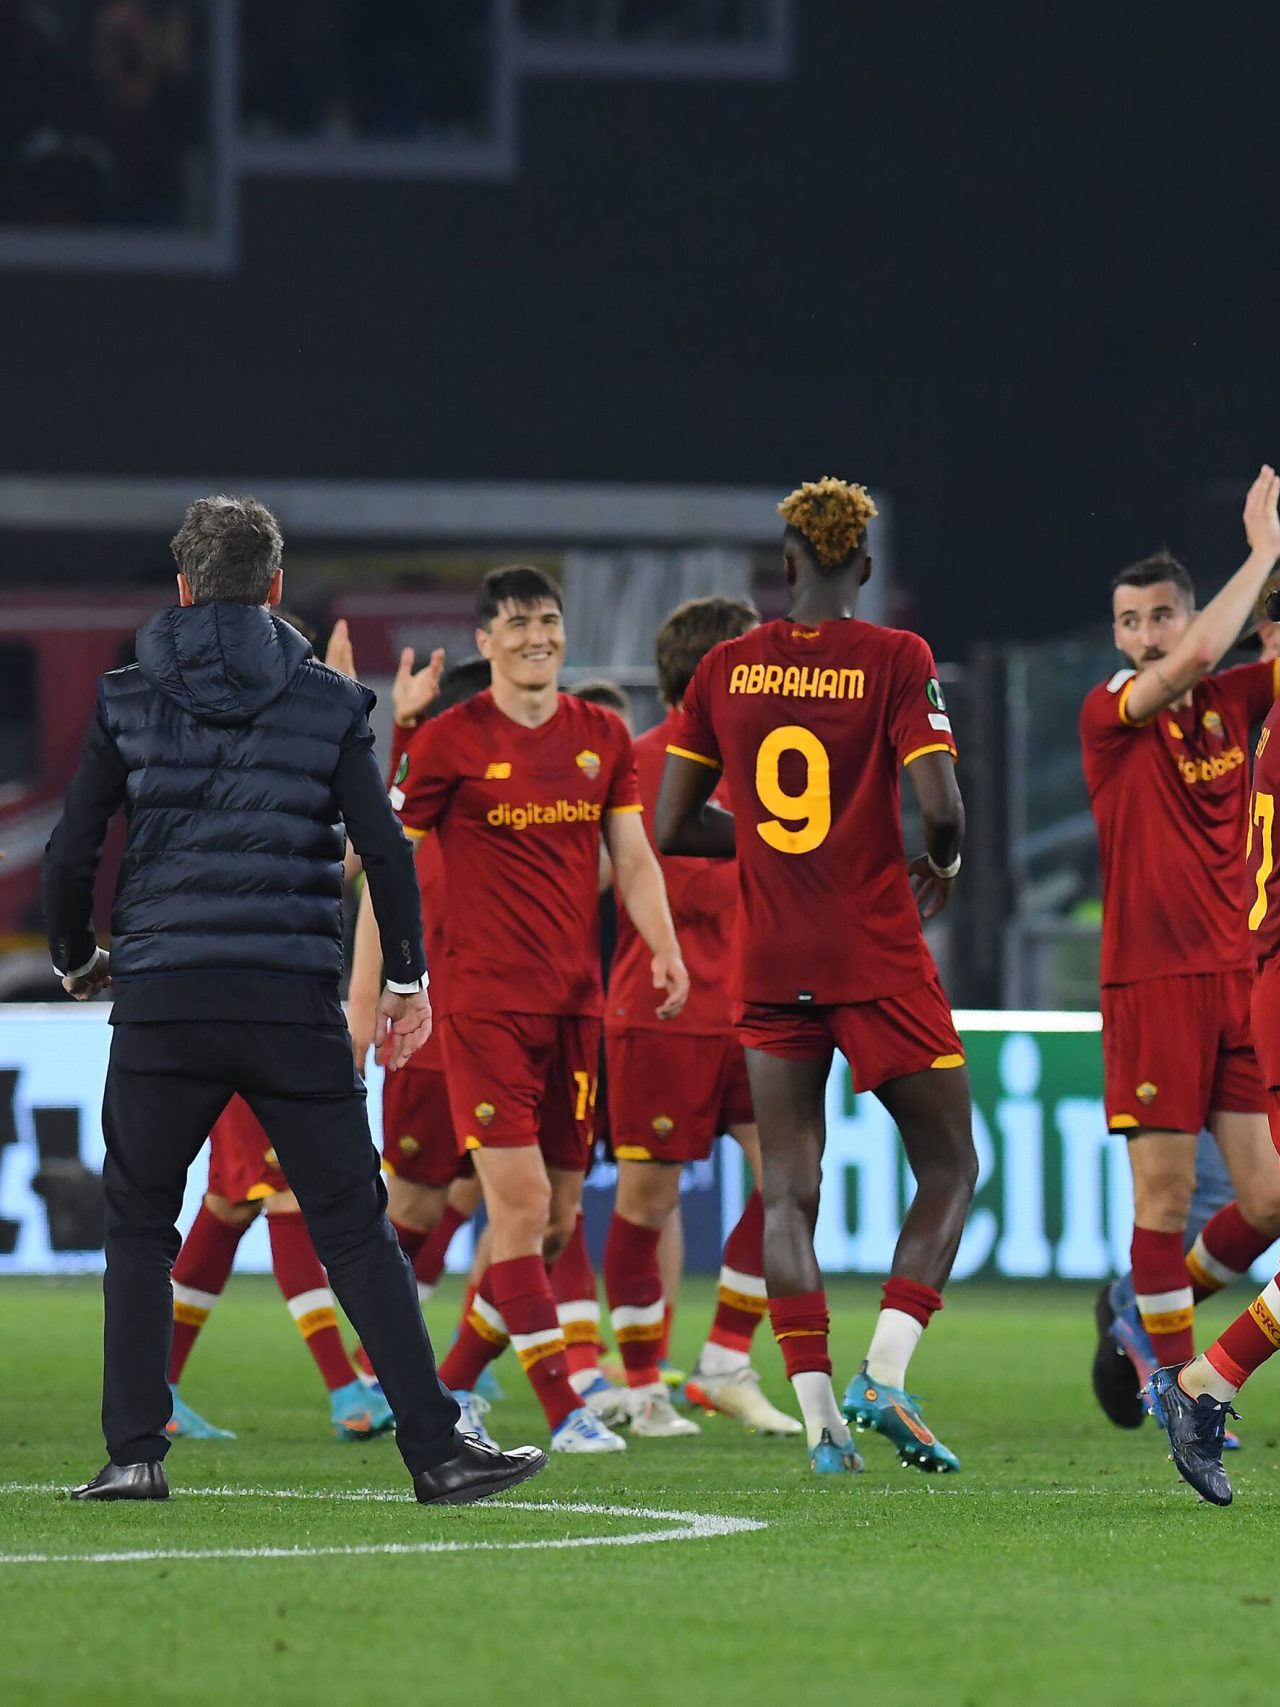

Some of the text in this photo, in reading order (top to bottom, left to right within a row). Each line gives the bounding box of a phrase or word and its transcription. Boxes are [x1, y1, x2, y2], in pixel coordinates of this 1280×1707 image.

[729, 663, 865, 700] ABRAHAM
[486, 799, 601, 831] digitalbits
[755, 725, 832, 854] 9
[1246, 790, 1275, 931] 7
[573, 1070, 598, 1121] 1
